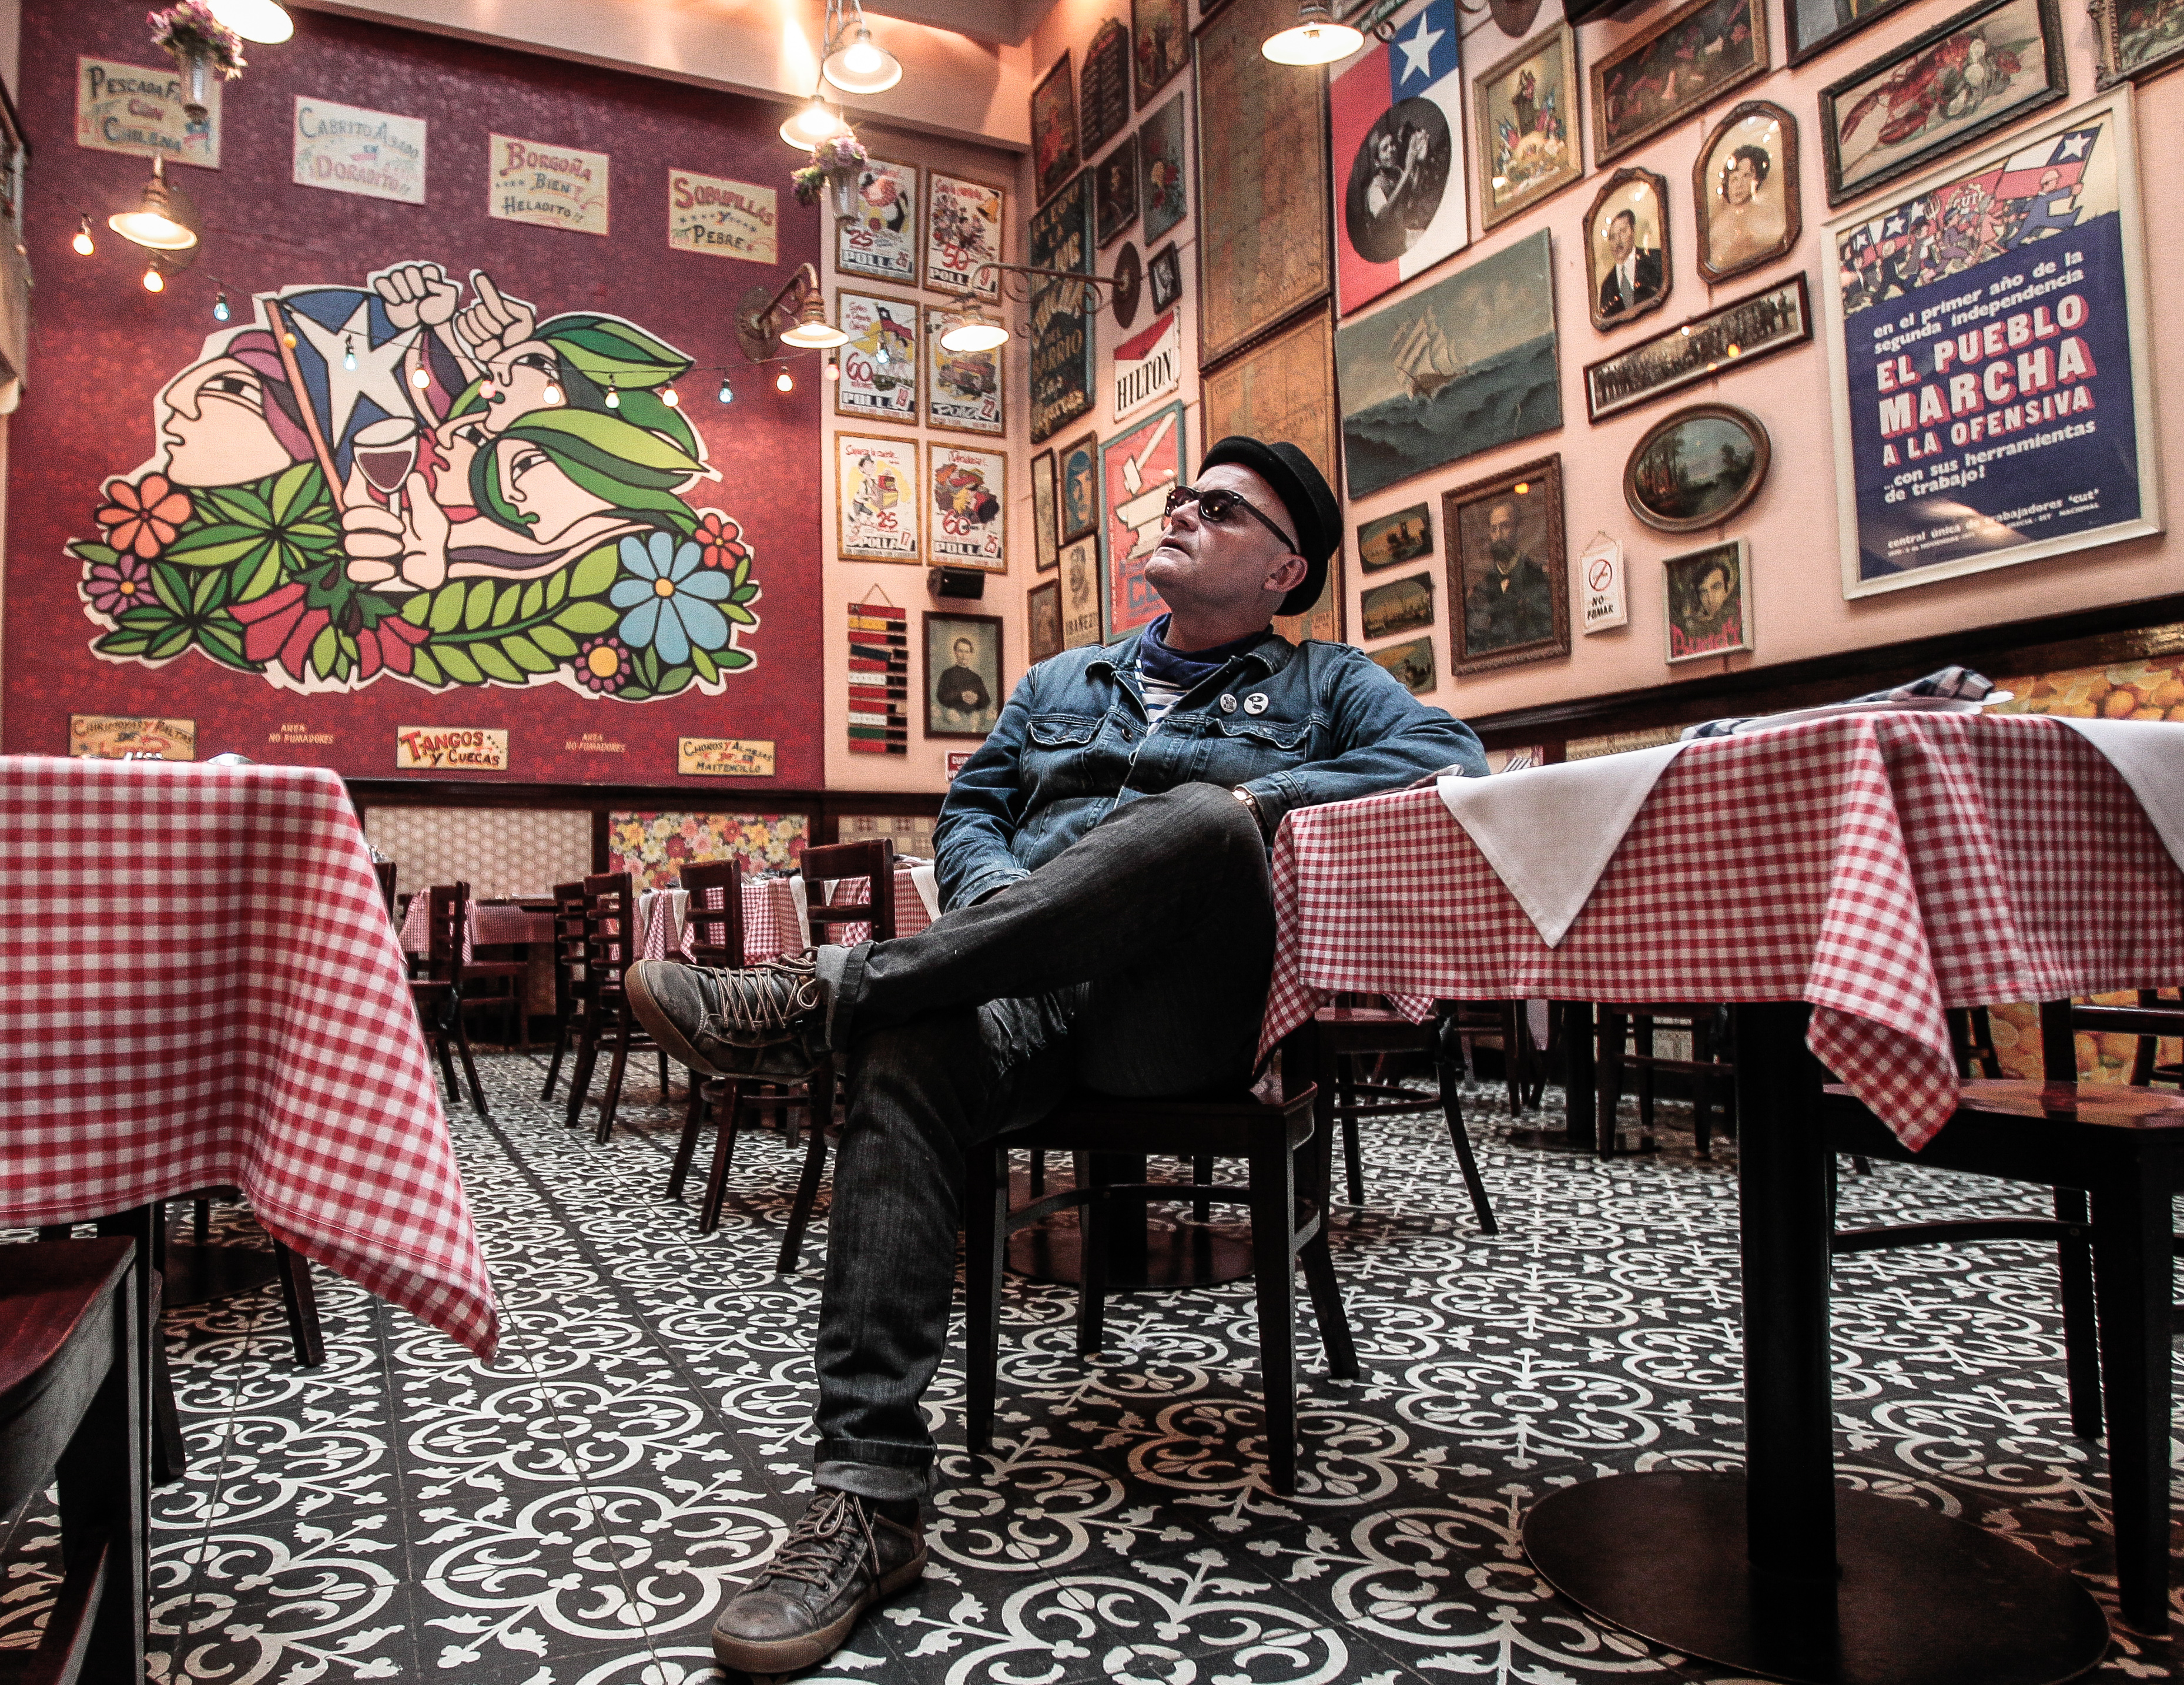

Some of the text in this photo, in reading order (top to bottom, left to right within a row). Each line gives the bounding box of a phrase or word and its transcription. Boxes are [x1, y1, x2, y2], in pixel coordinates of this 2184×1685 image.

[299, 106, 371, 139] CABRITO
[530, 172, 570, 193] BIEN
[693, 225, 744, 249] PEBRE
[1874, 251, 2083, 339] en el primer año de la
[1875, 269, 2084, 354] segunda independencia
[1877, 294, 2086, 392] EL PUEBLO
[846, 352, 875, 382] 60
[1117, 349, 1171, 411] HILTON
[1879, 336, 2093, 437] MARCHA
[1883, 386, 2093, 467] A LA OFENSIVA
[1930, 460, 1958, 477] sus
[1965, 420, 2095, 467] herramientas
[1884, 489, 1905, 504] de
[876, 510, 899, 530] 25
[942, 508, 972, 536] 60
[1888, 531, 1926, 549] central
[1931, 523, 1961, 538] única
[1586, 604, 1614, 621] FUMAR
[1591, 594, 1605, 607] NO
[269, 733, 334, 745] NO FUMADORES
[399, 731, 484, 763] TANGOS
[565, 741, 577, 751] NO
[447, 749, 500, 766] CUECAS
